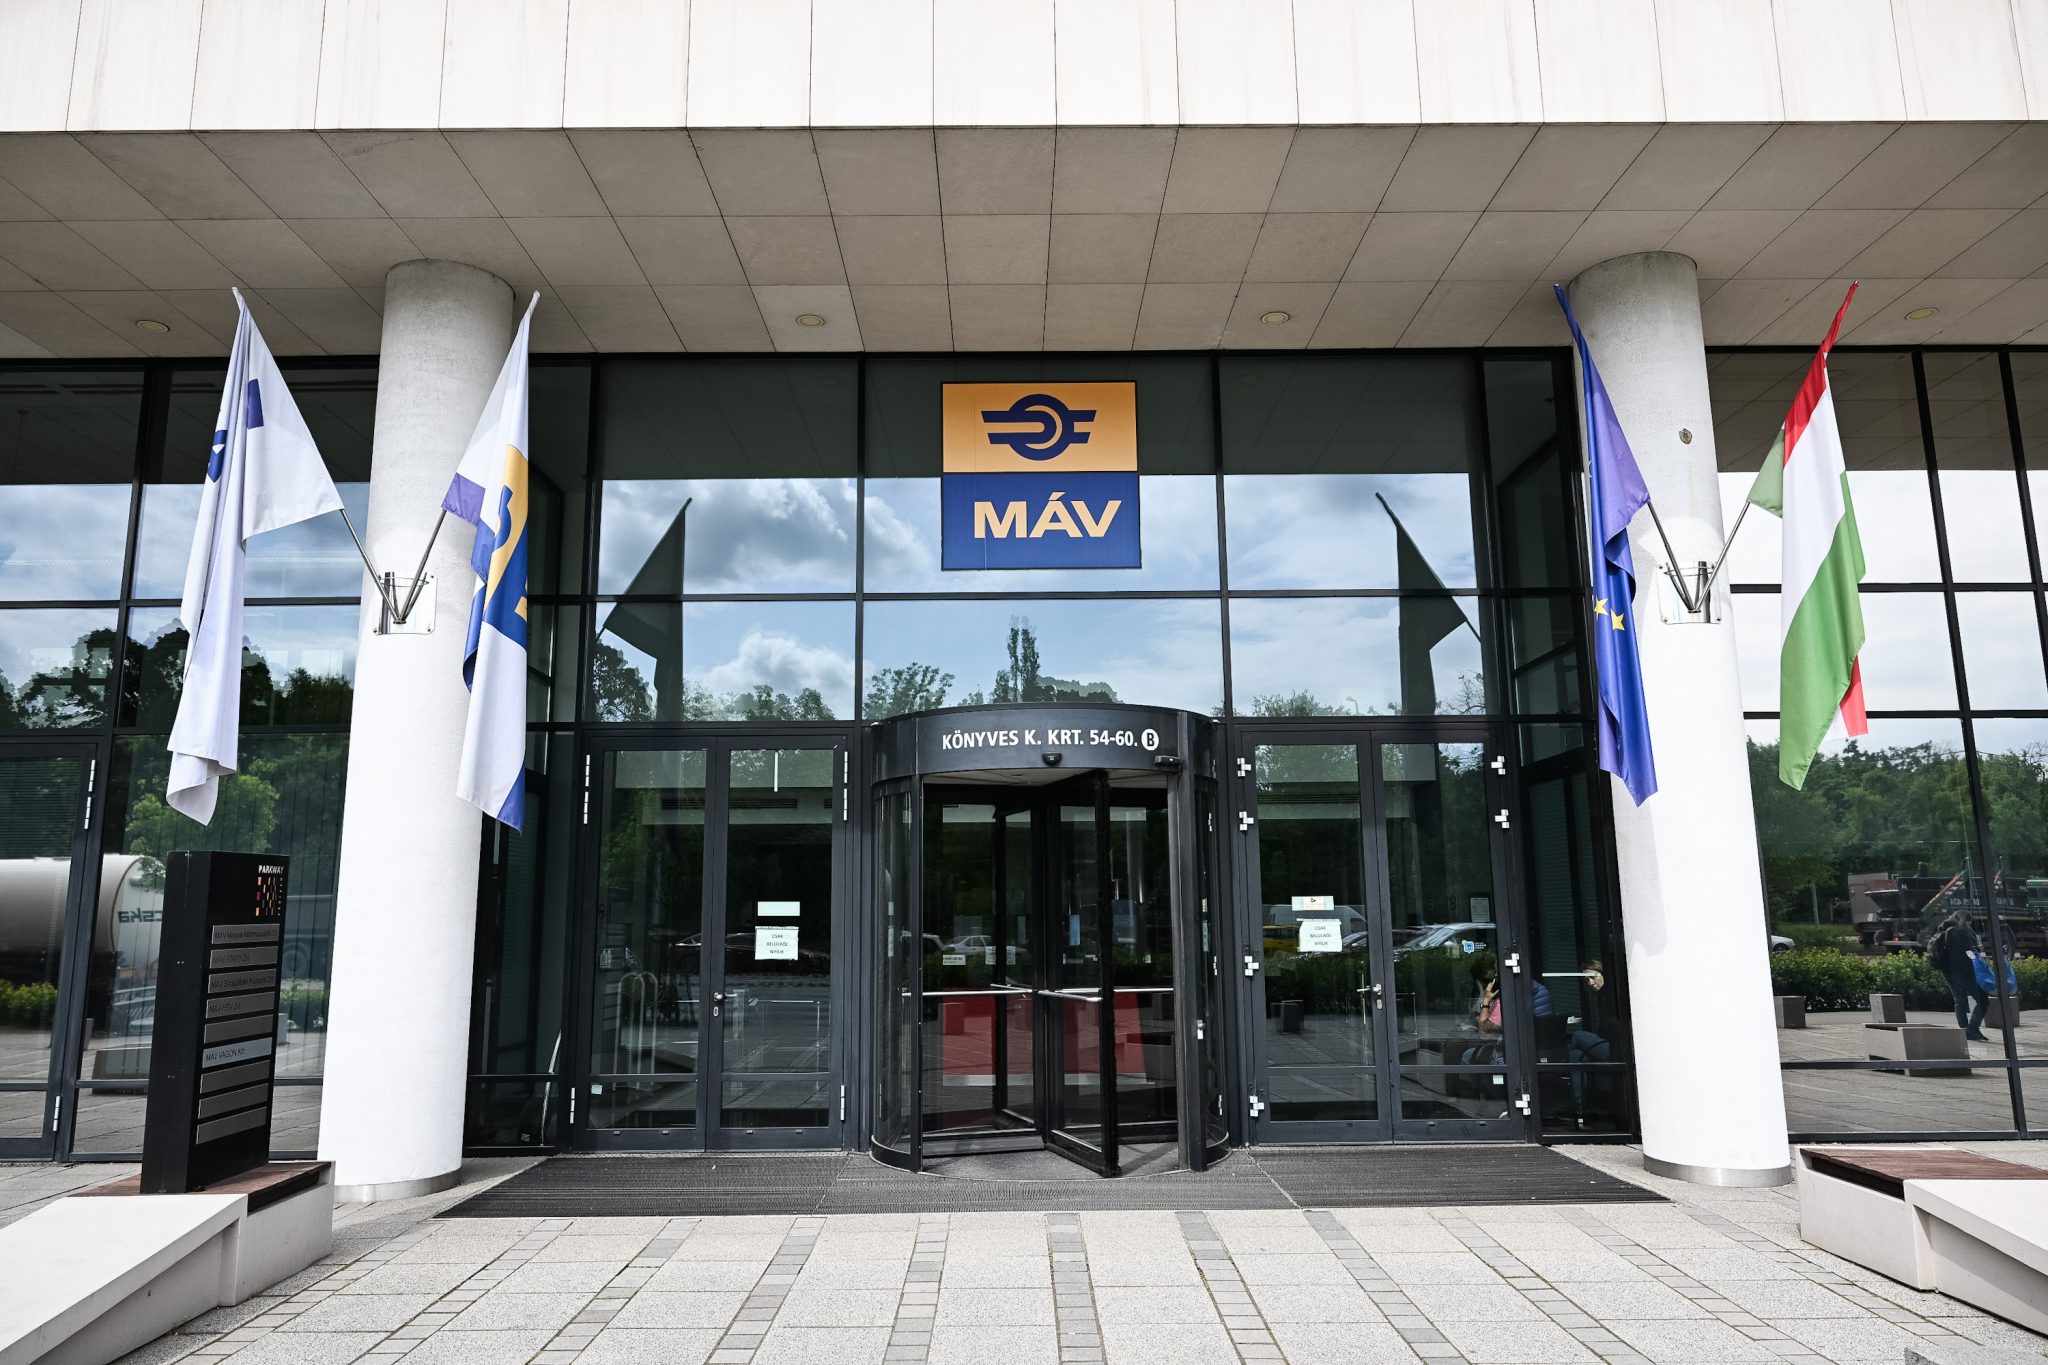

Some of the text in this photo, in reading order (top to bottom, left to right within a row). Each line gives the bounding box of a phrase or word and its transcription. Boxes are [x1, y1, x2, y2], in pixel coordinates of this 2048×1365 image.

[974, 491, 1123, 539] MÁV
[942, 730, 1019, 750] KÖNYVES
[1024, 729, 1042, 746] K.
[1048, 729, 1084, 745] KRT.
[1089, 729, 1138, 747] 54-60.
[258, 864, 284, 874] PARKWAY
